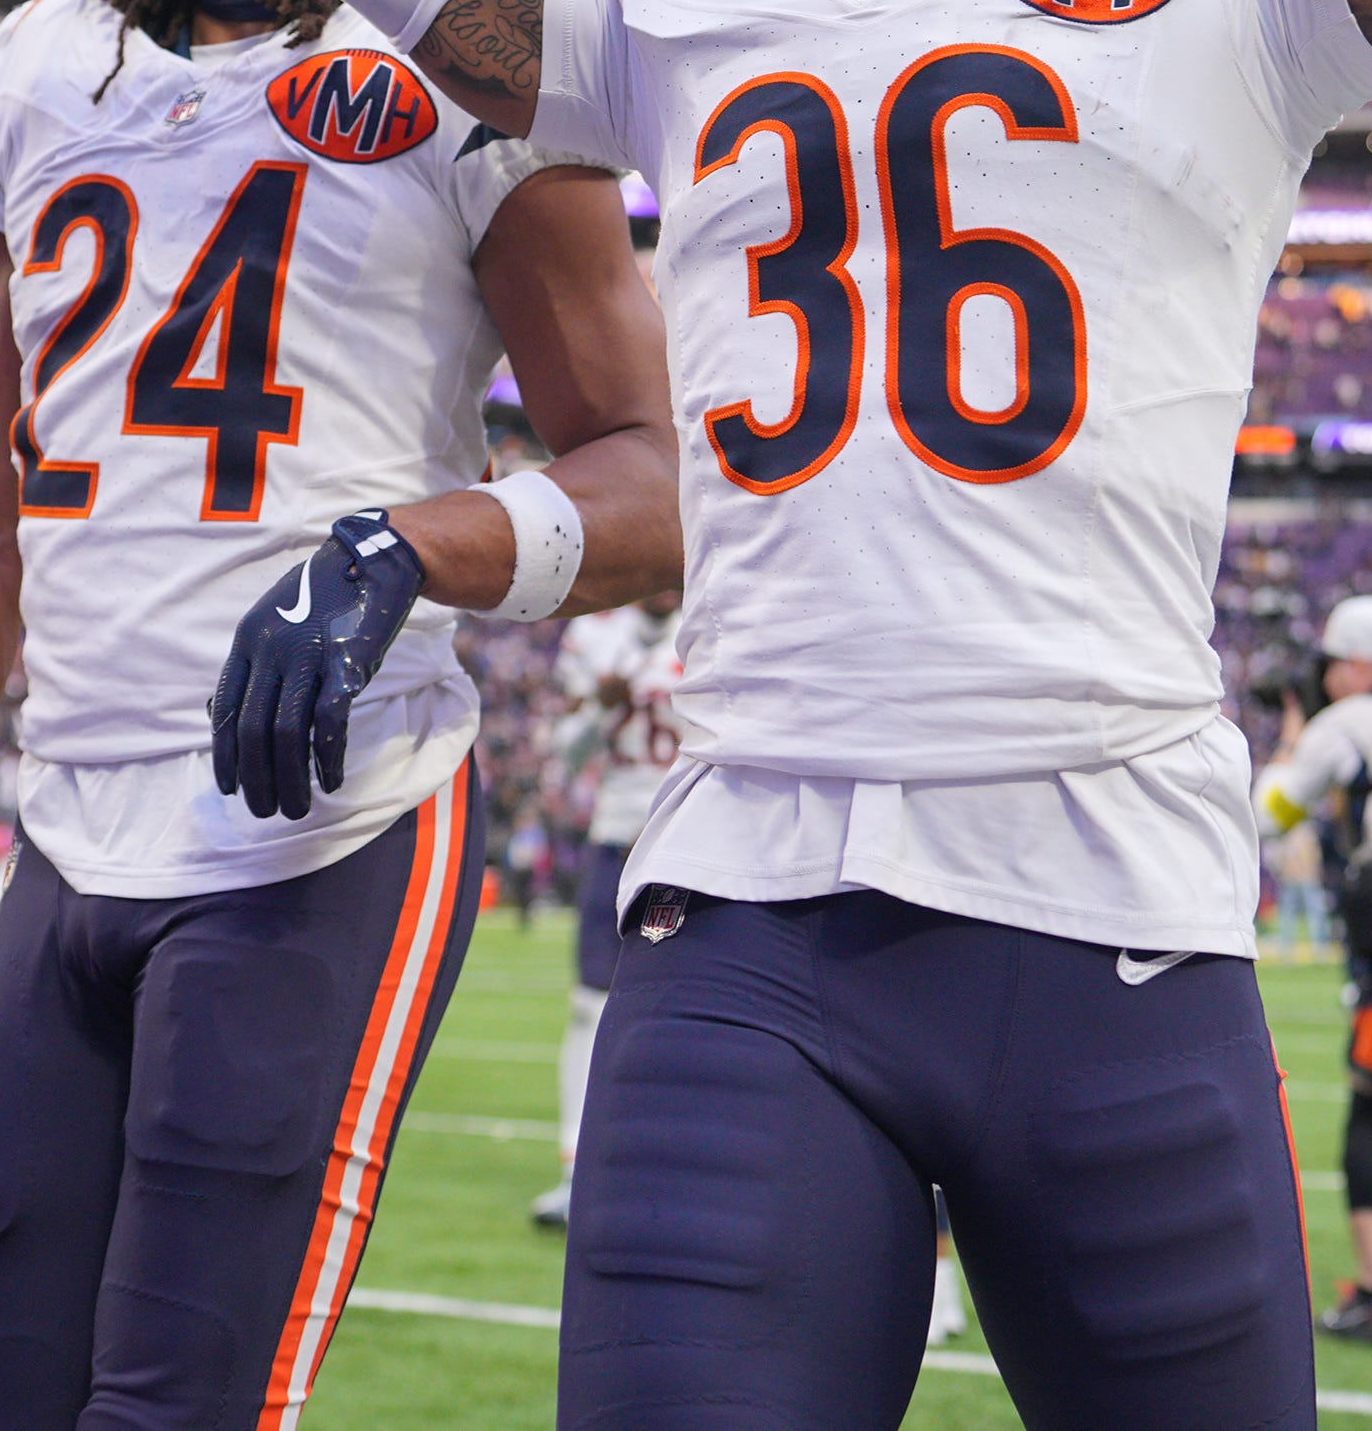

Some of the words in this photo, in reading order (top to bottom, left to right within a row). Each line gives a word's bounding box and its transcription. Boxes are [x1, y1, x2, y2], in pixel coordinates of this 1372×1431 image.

[287, 56, 421, 154] VMH
[9, 160, 309, 522] 24
[693, 42, 1089, 496] 36
[647, 906, 676, 930] NFL
